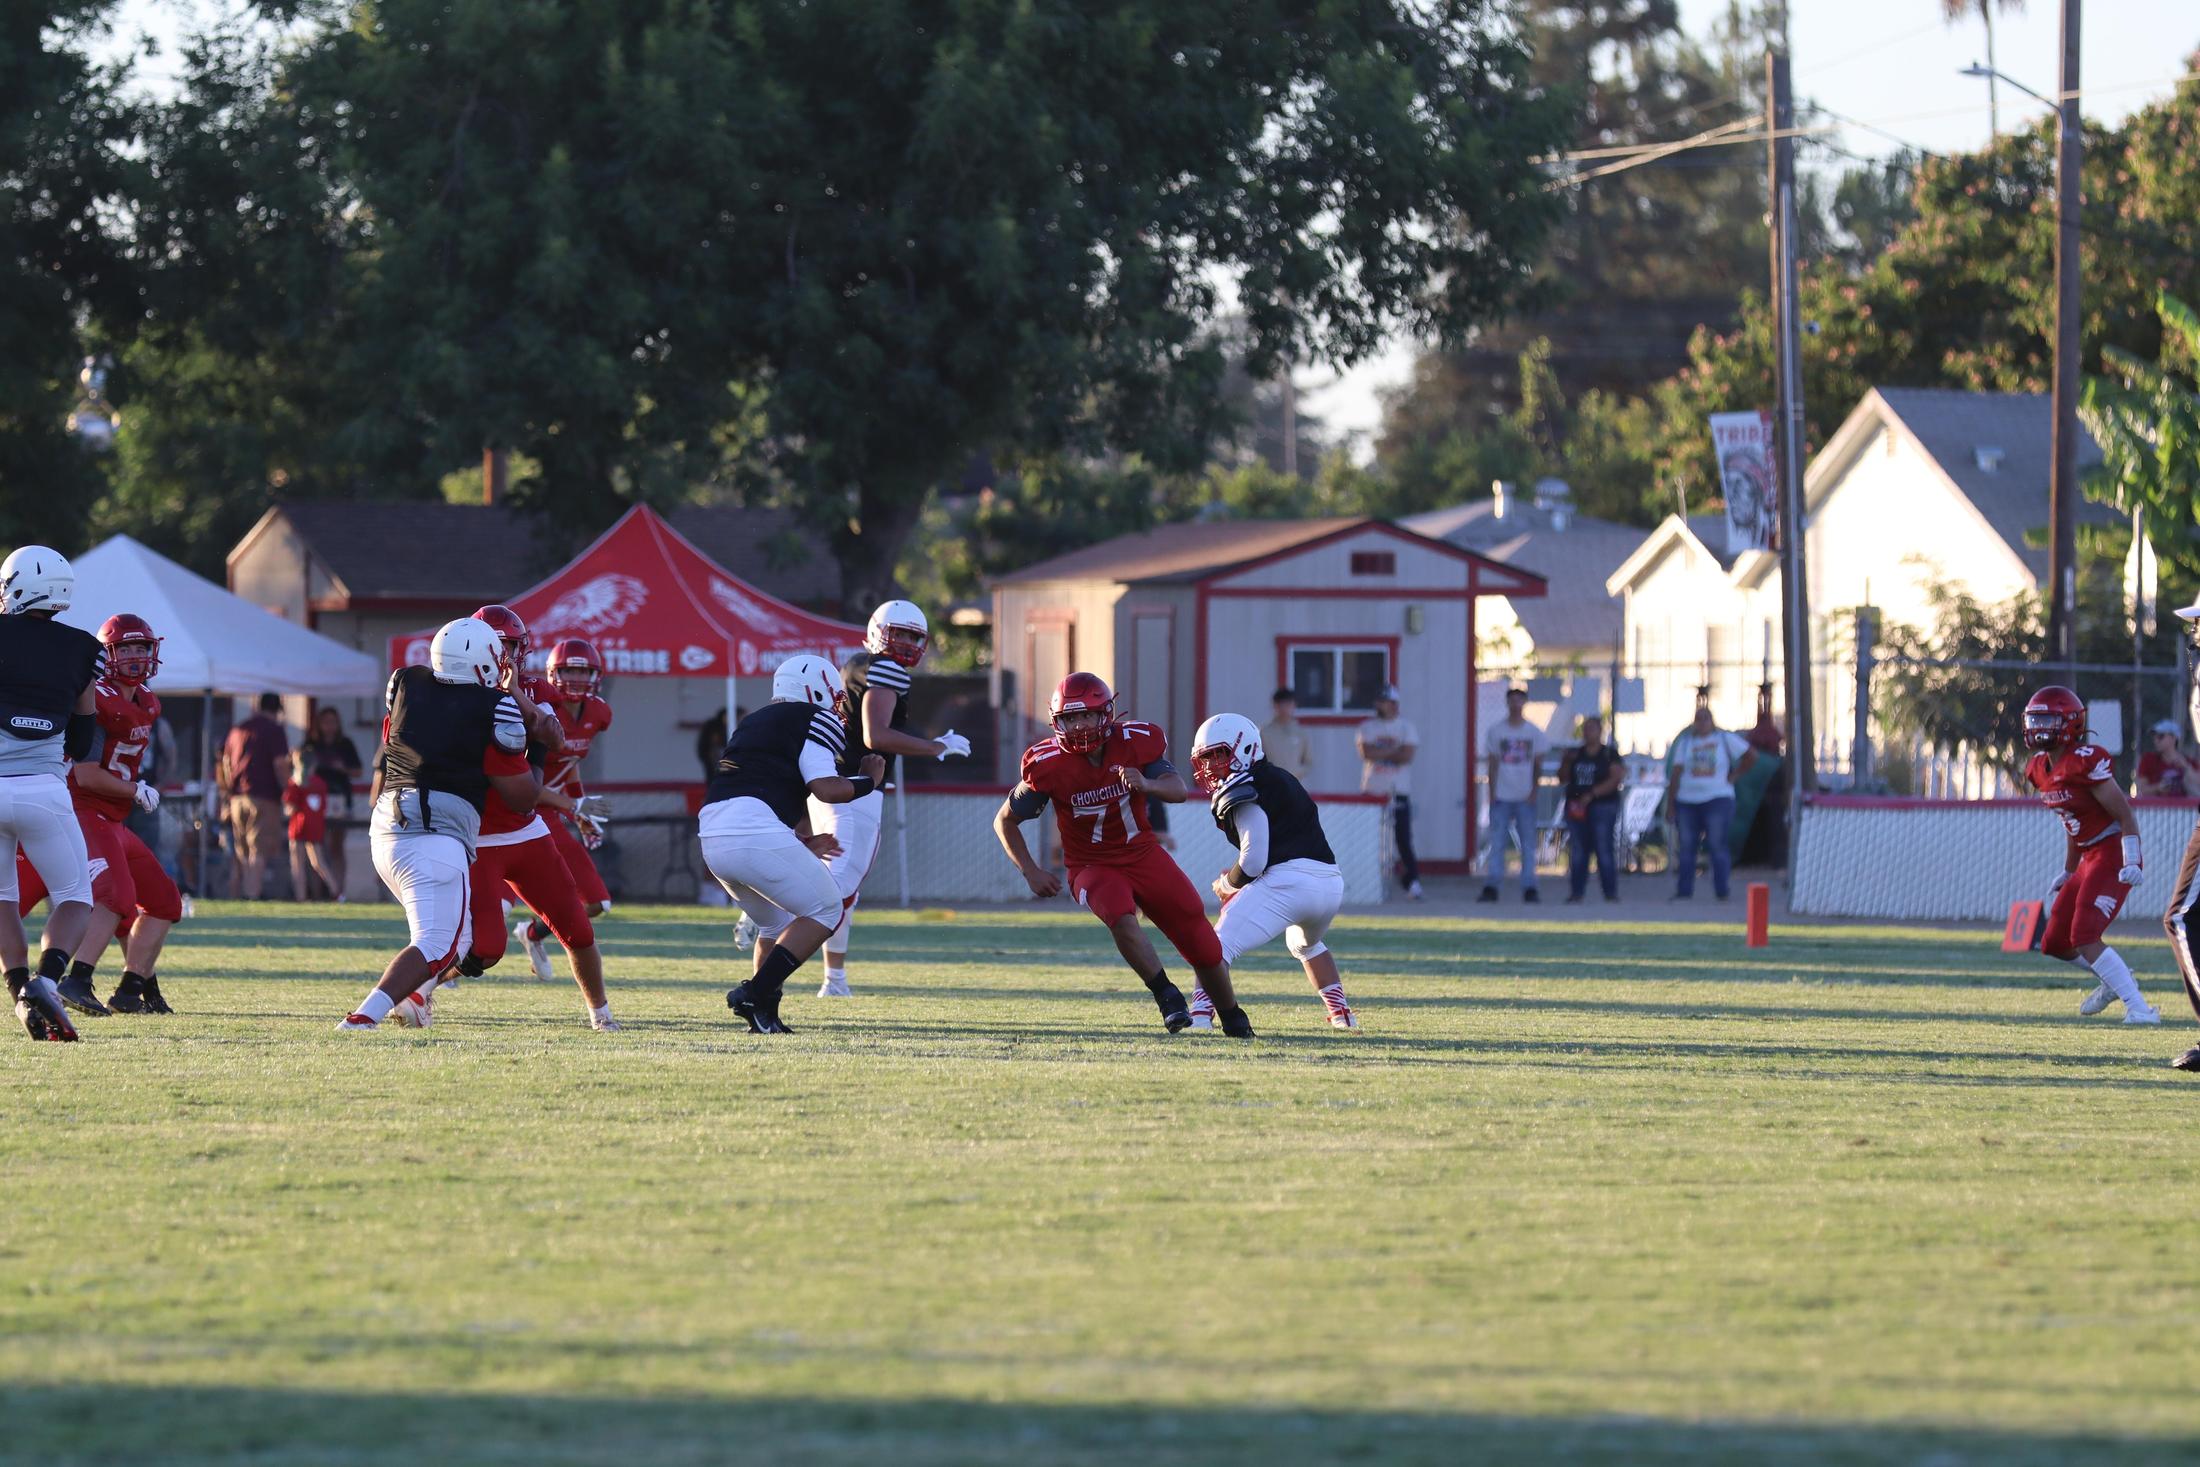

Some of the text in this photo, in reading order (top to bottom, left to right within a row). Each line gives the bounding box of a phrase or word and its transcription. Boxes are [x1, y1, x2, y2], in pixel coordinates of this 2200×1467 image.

[604, 650, 670, 673] TRIBE
[15, 719, 50, 729] BATTLE
[1070, 783, 1129, 808] CHOWCHILL
[1072, 794, 1142, 845] 71
[2011, 906, 2029, 944] G
